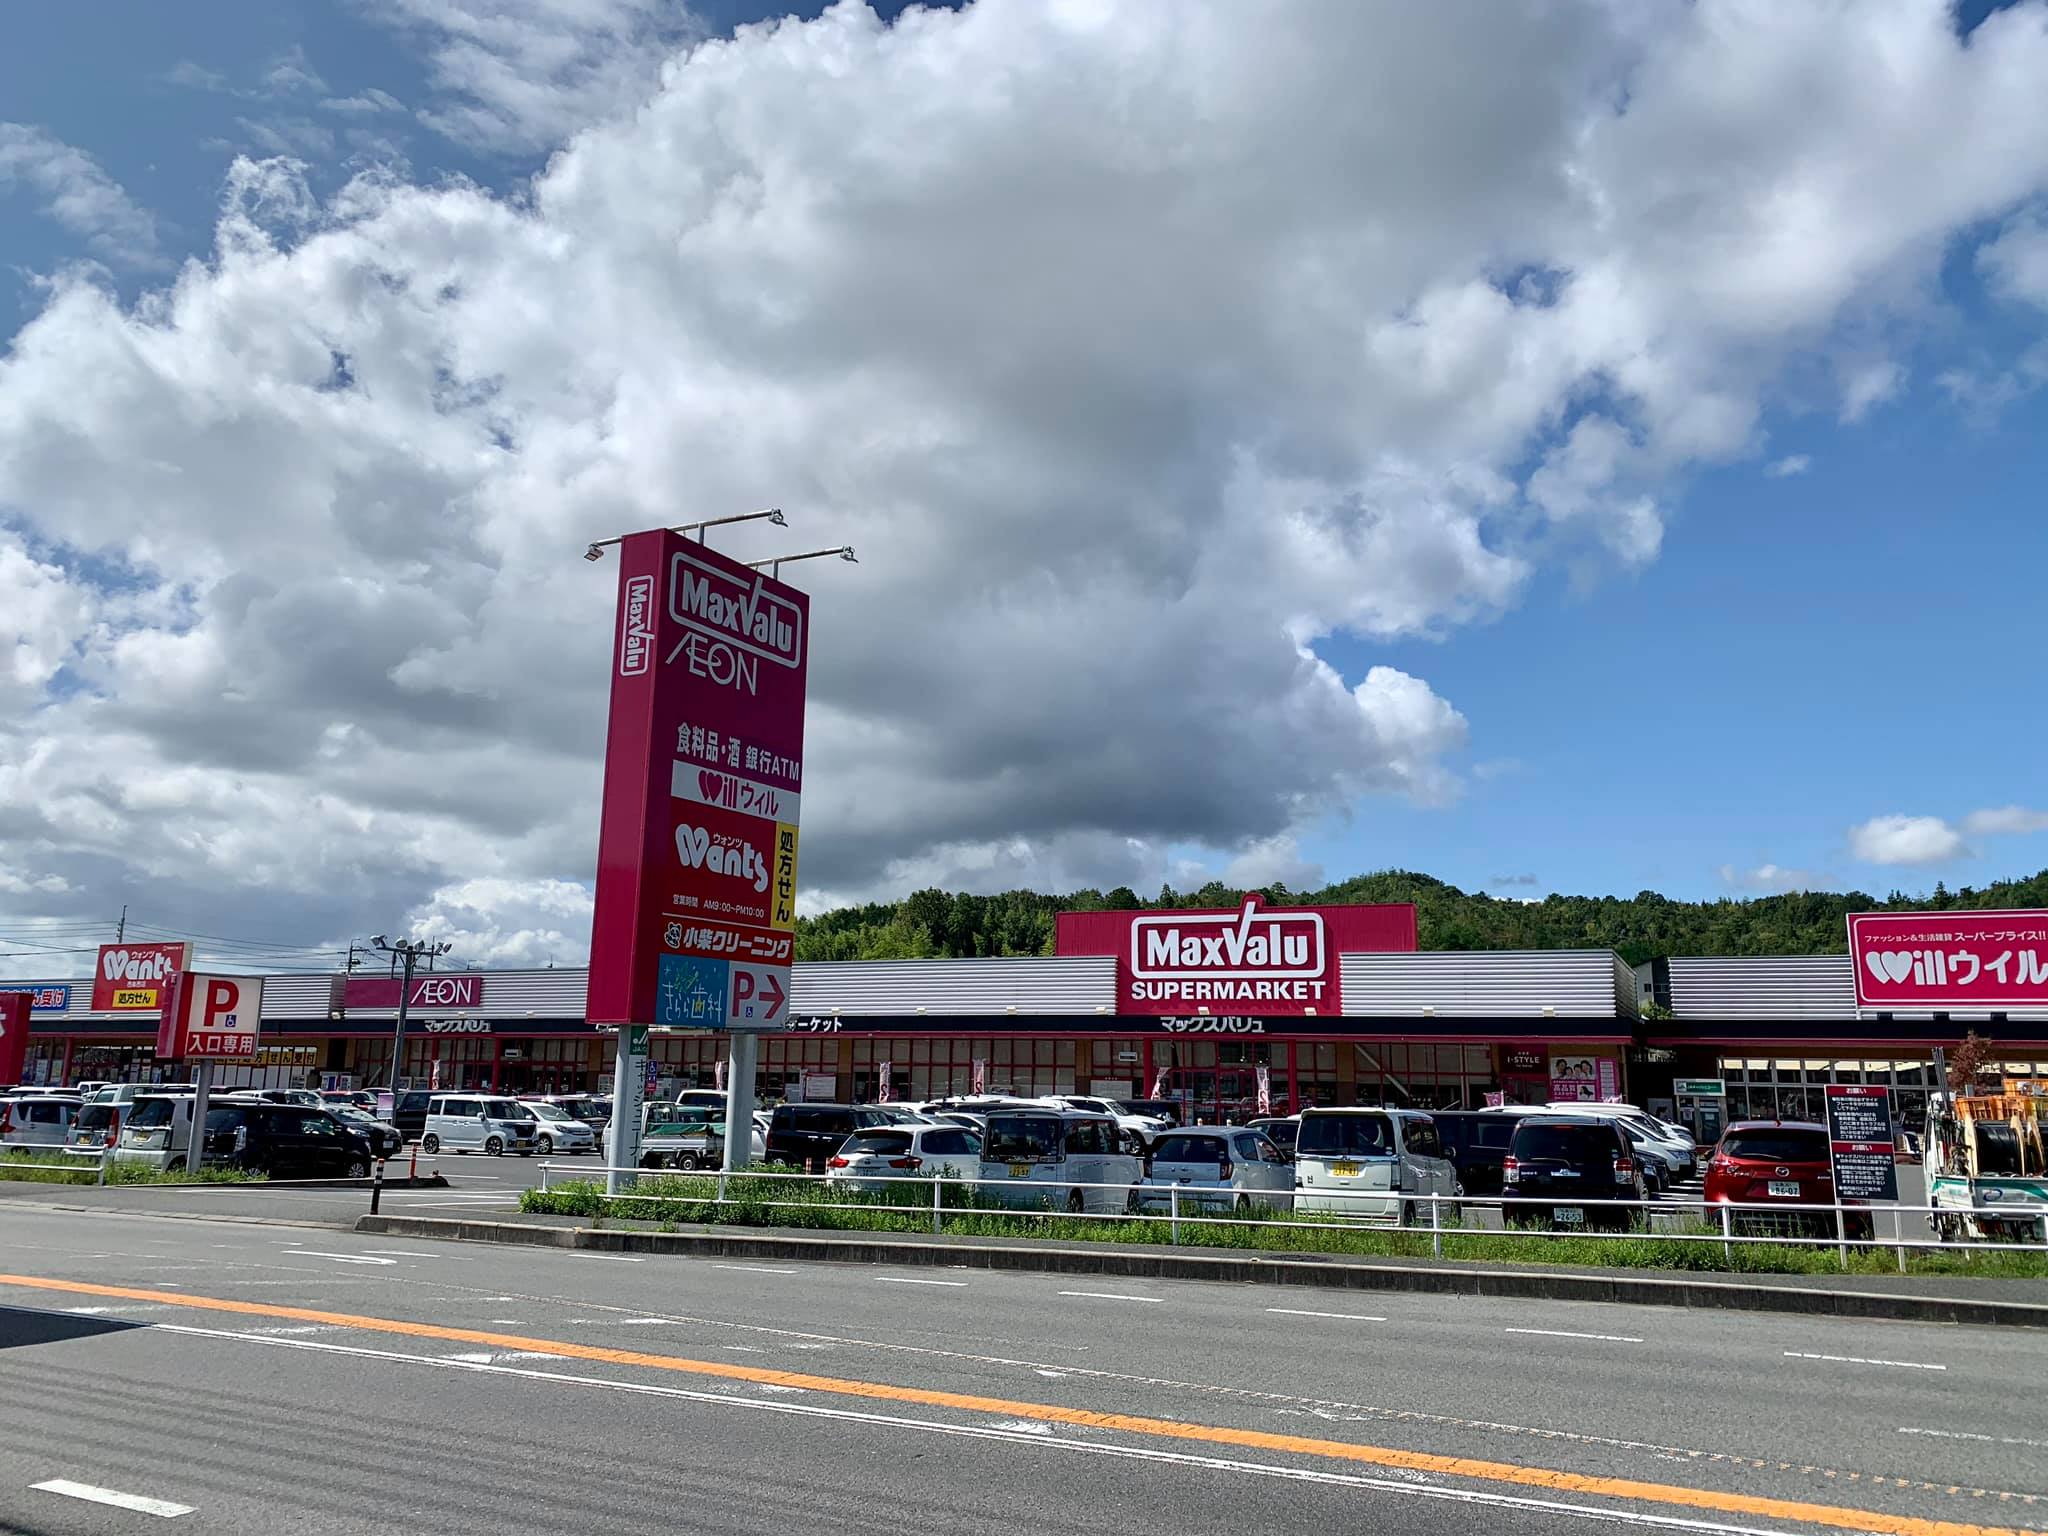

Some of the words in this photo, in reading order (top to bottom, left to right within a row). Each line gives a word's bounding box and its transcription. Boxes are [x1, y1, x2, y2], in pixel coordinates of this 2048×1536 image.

[626, 583, 655, 668] MaxValu
[682, 570, 792, 653] MaxValu
[677, 722, 741, 768] 食料品・酒
[745, 745, 800, 781] 銀行ATM
[675, 823, 768, 893] Wants
[713, 832, 743, 848] ウォンツ
[776, 830, 793, 923] 処方せん
[684, 927, 791, 958] 小柴クリーニング
[1147, 901, 1308, 967] MaxValu
[203, 979, 239, 1027] P
[733, 970, 755, 1018] P
[1131, 981, 1326, 1000] SUPERMARKET
[188, 1034, 253, 1055] 入口専用
[1160, 1016, 1265, 1033] マックスバリュ
